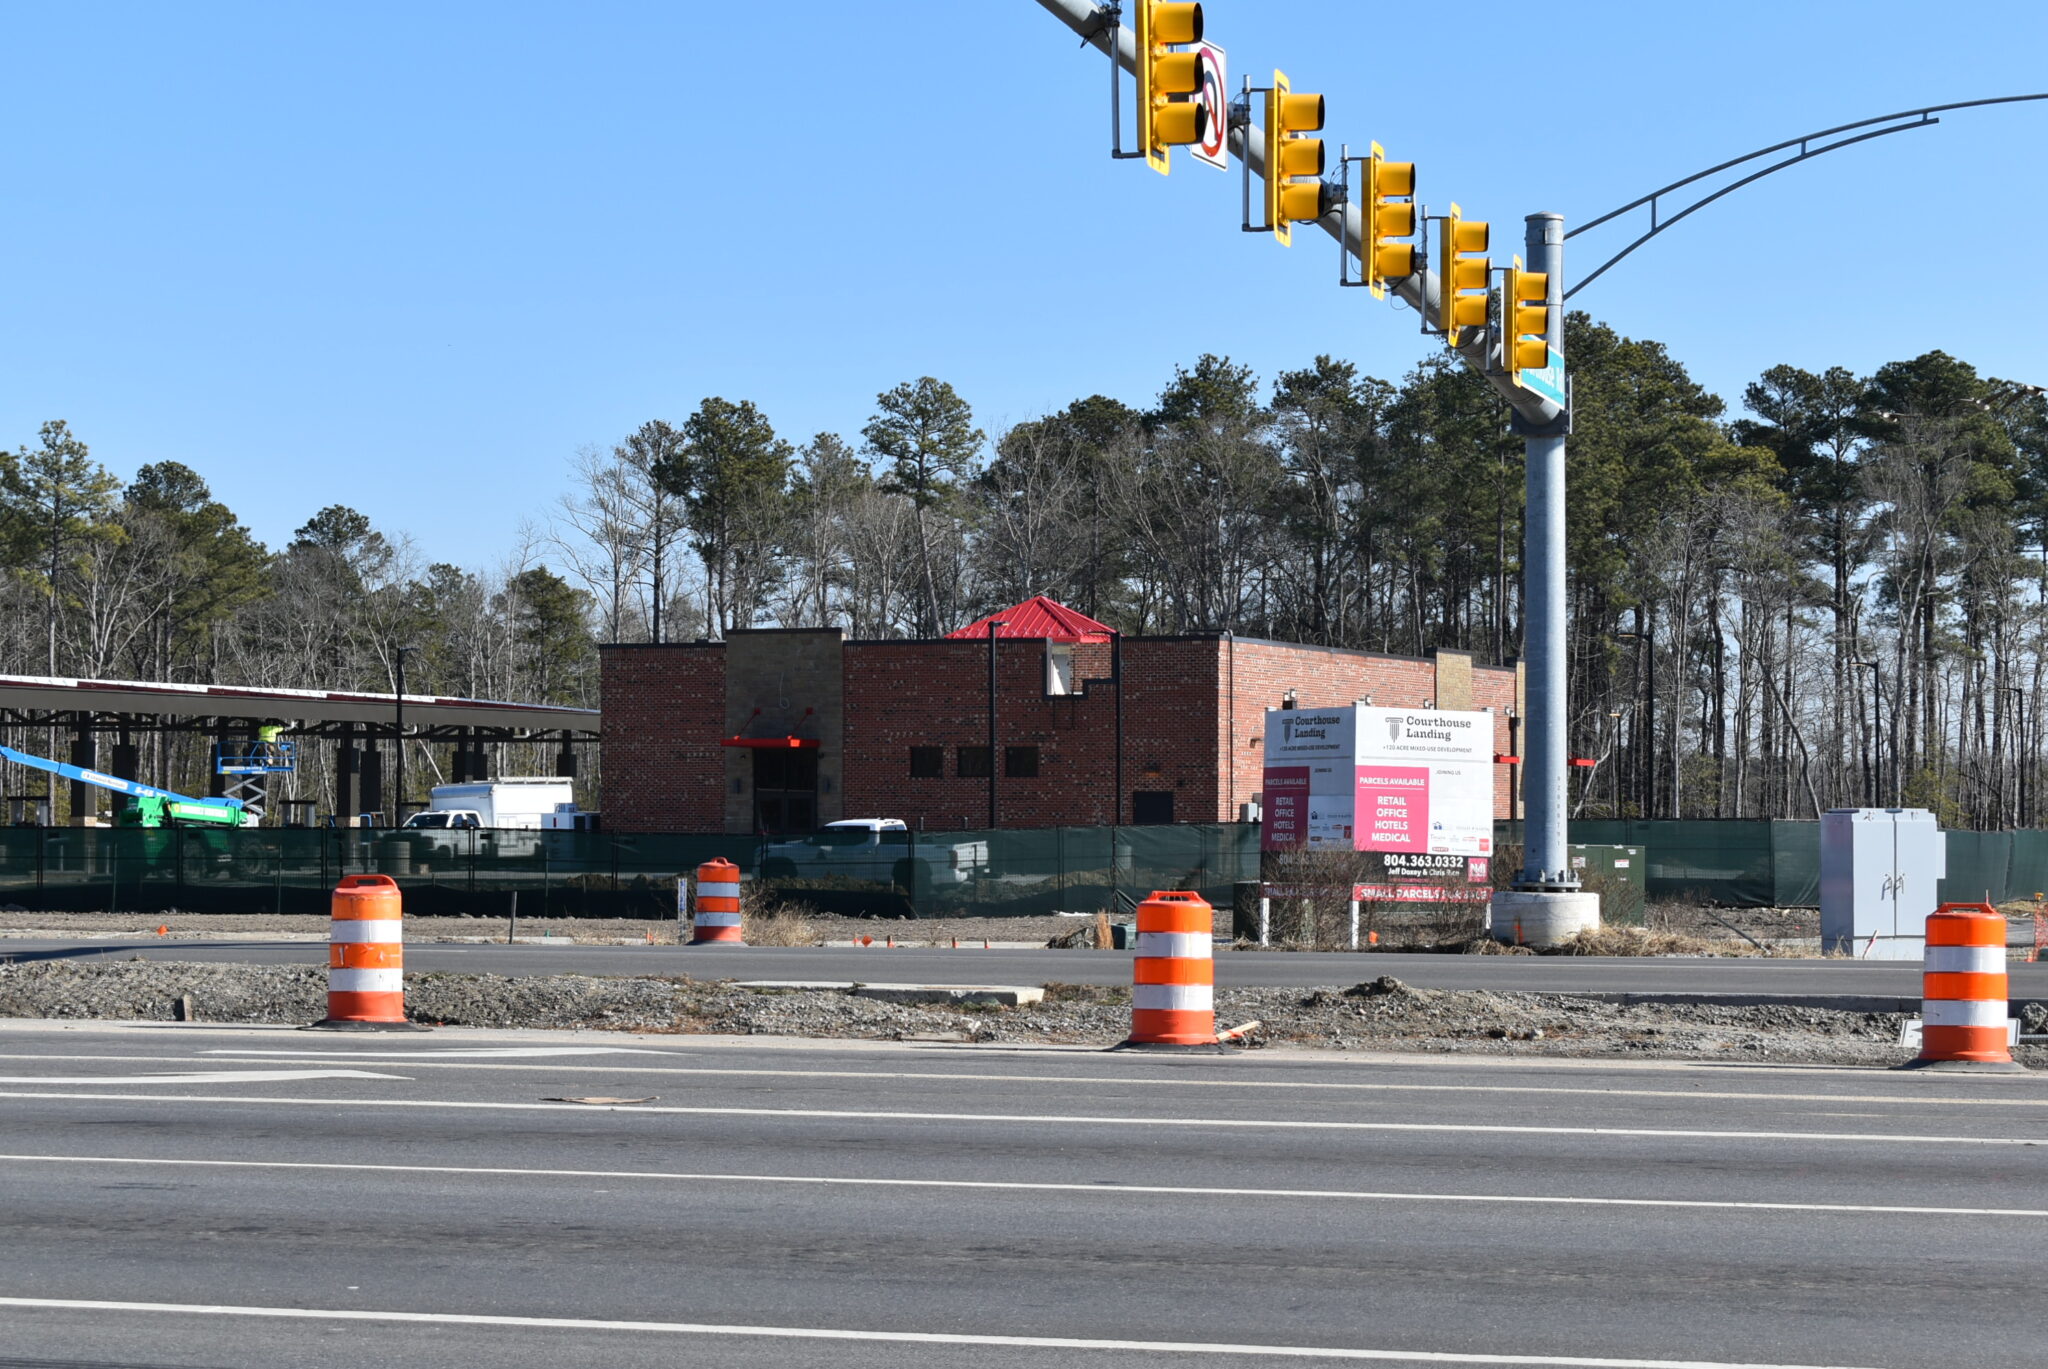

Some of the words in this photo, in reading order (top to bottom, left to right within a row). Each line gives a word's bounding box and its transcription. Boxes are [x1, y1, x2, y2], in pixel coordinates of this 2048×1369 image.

[1295, 715, 1341, 726] Courthouse
[1406, 715, 1472, 728] Courthouse
[1294, 728, 1326, 740] Landing
[1406, 728, 1452, 742] Landing
[1359, 776, 1389, 785] PARCELS
[1389, 777, 1425, 786] AVAILABLE
[1275, 797, 1294, 806] RETAIL
[1377, 795, 1407, 806] RETAIL
[1274, 808, 1295, 817] OFFICE
[1376, 808, 1408, 818] OFFICE
[1273, 820, 1295, 829] HOTELS
[1375, 820, 1408, 830] HOTELS
[1271, 832, 1296, 842] MEDICAL
[1371, 832, 1411, 842] MEDICAL
[1383, 854, 1464, 868] 804.363.0332
[1387, 867, 1401, 875] Jeff
[1422, 868, 1428, 876] &
[1361, 888, 1394, 898] SMALL
[1396, 889, 1439, 899] PARCELS
